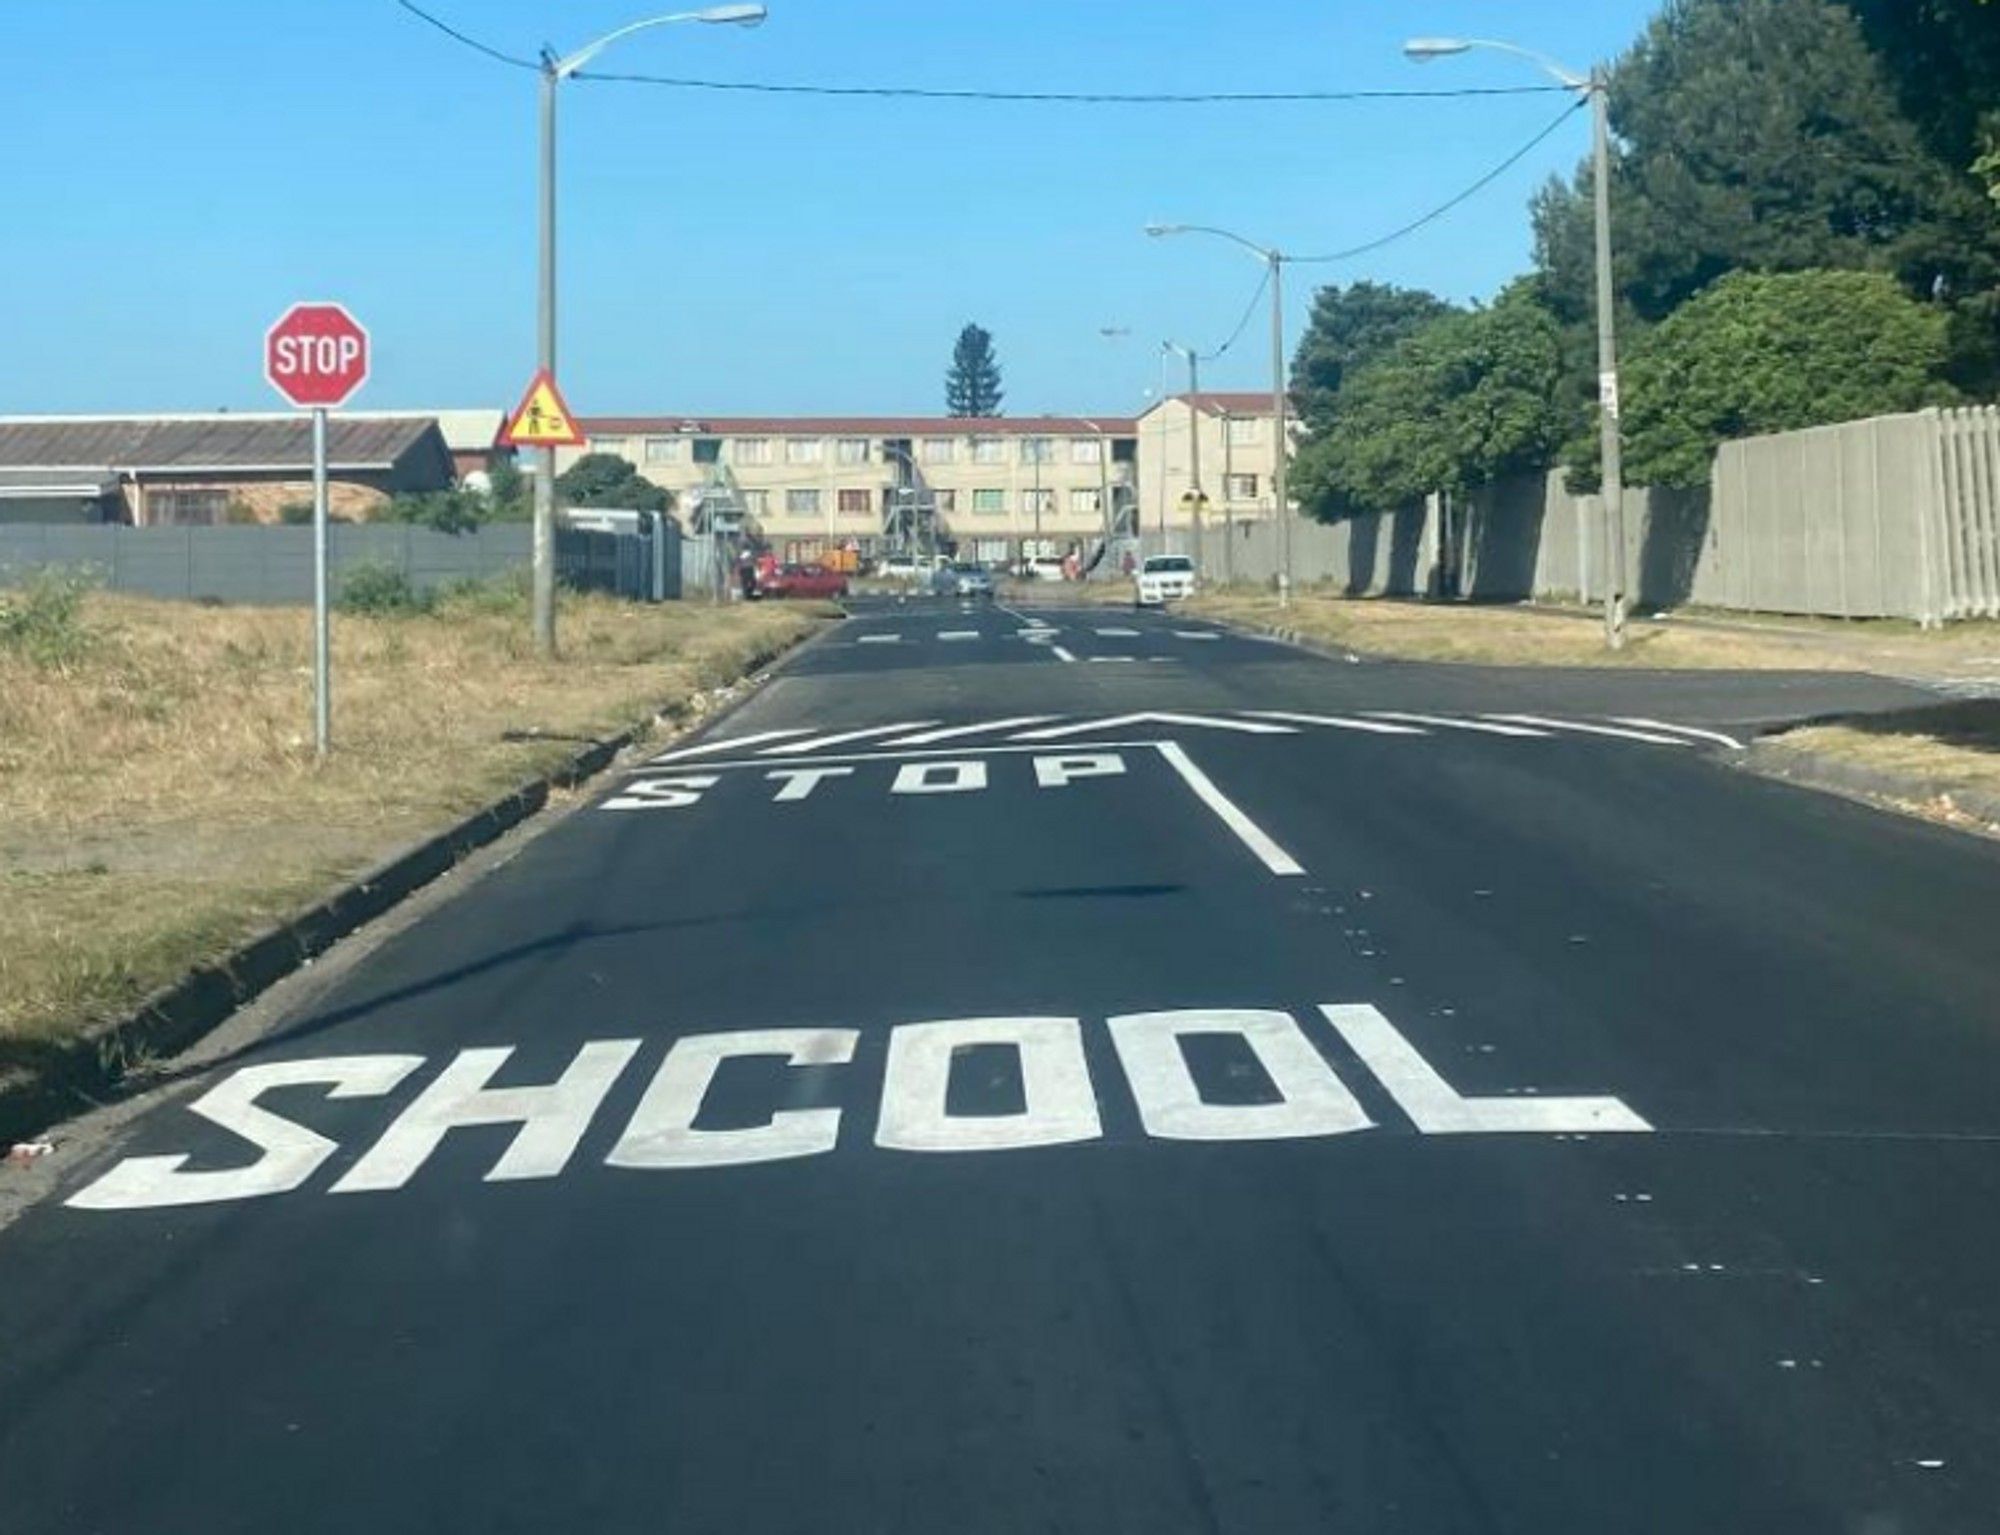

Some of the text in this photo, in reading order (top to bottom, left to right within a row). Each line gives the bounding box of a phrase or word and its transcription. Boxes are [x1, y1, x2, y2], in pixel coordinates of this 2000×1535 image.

[276, 335, 360, 374] STOP
[598, 754, 1126, 810] STOP
[64, 1003, 1655, 1210] SHCOOL
